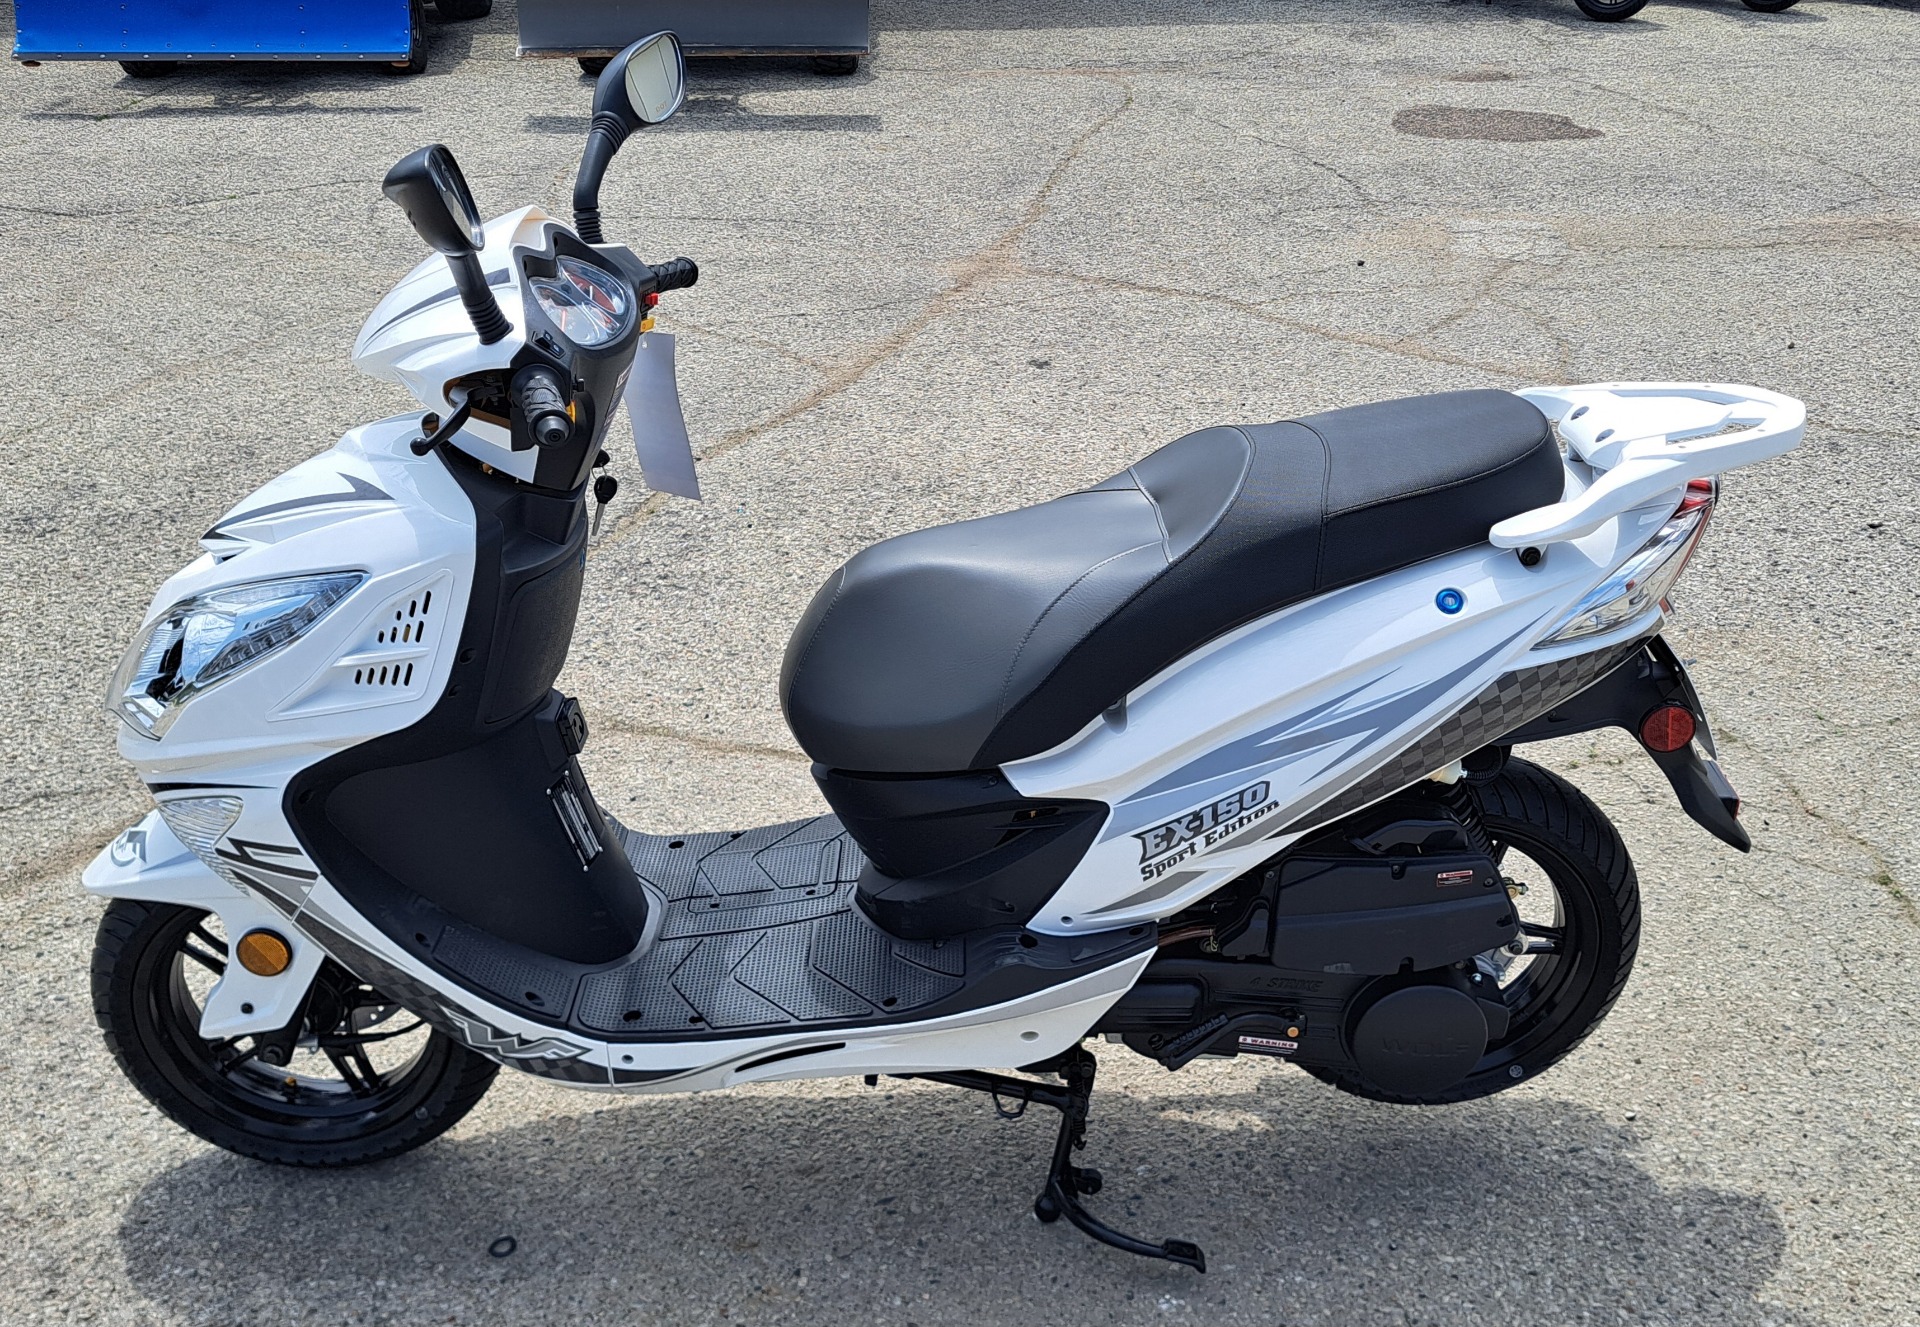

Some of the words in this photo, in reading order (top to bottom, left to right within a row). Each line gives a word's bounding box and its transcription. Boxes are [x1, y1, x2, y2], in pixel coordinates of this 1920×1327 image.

[1132, 781, 1270, 864] EX-150
[1140, 844, 1197, 882] Sport
[1204, 799, 1280, 849] Edition
[1250, 1038, 1295, 1048] WARNING
[1381, 1037, 1470, 1057] WOLF
